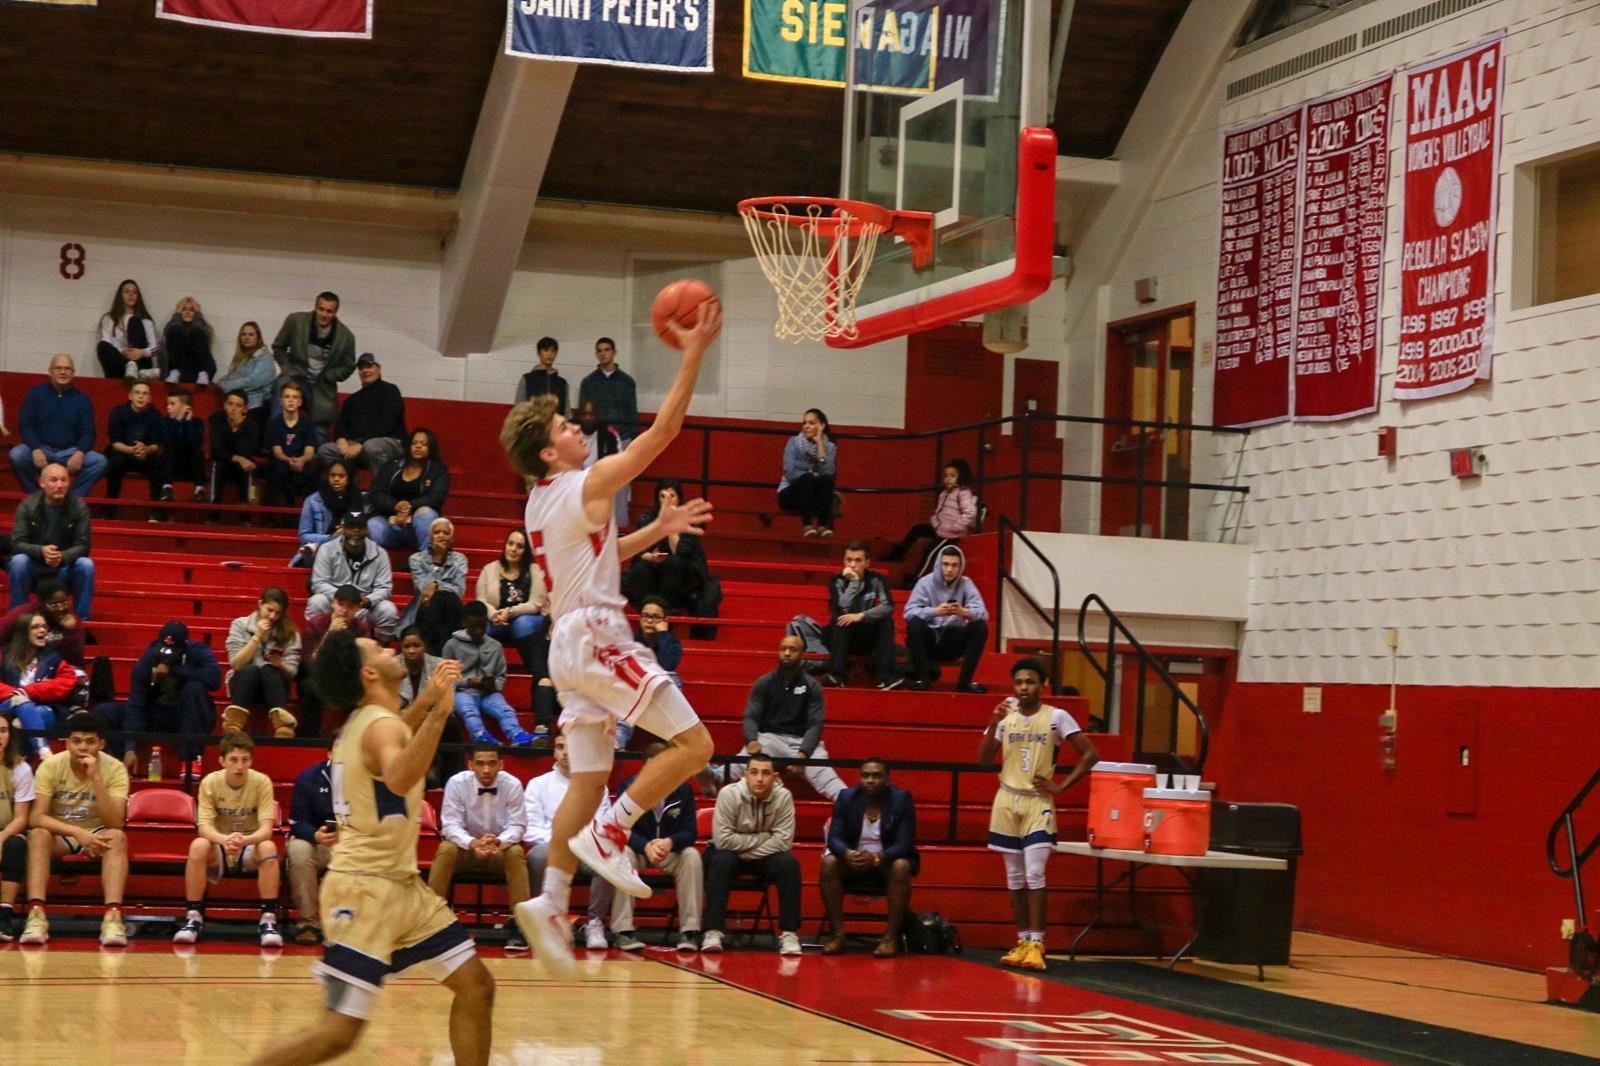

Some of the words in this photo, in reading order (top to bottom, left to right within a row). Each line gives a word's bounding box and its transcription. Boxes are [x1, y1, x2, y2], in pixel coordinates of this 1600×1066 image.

[1410, 48, 1496, 135] MAAC
[60, 242, 85, 280] 8
[1402, 235, 1448, 271] REGULAR
[1430, 306, 1458, 331] 1997
[1020, 747, 1032, 773] 3
